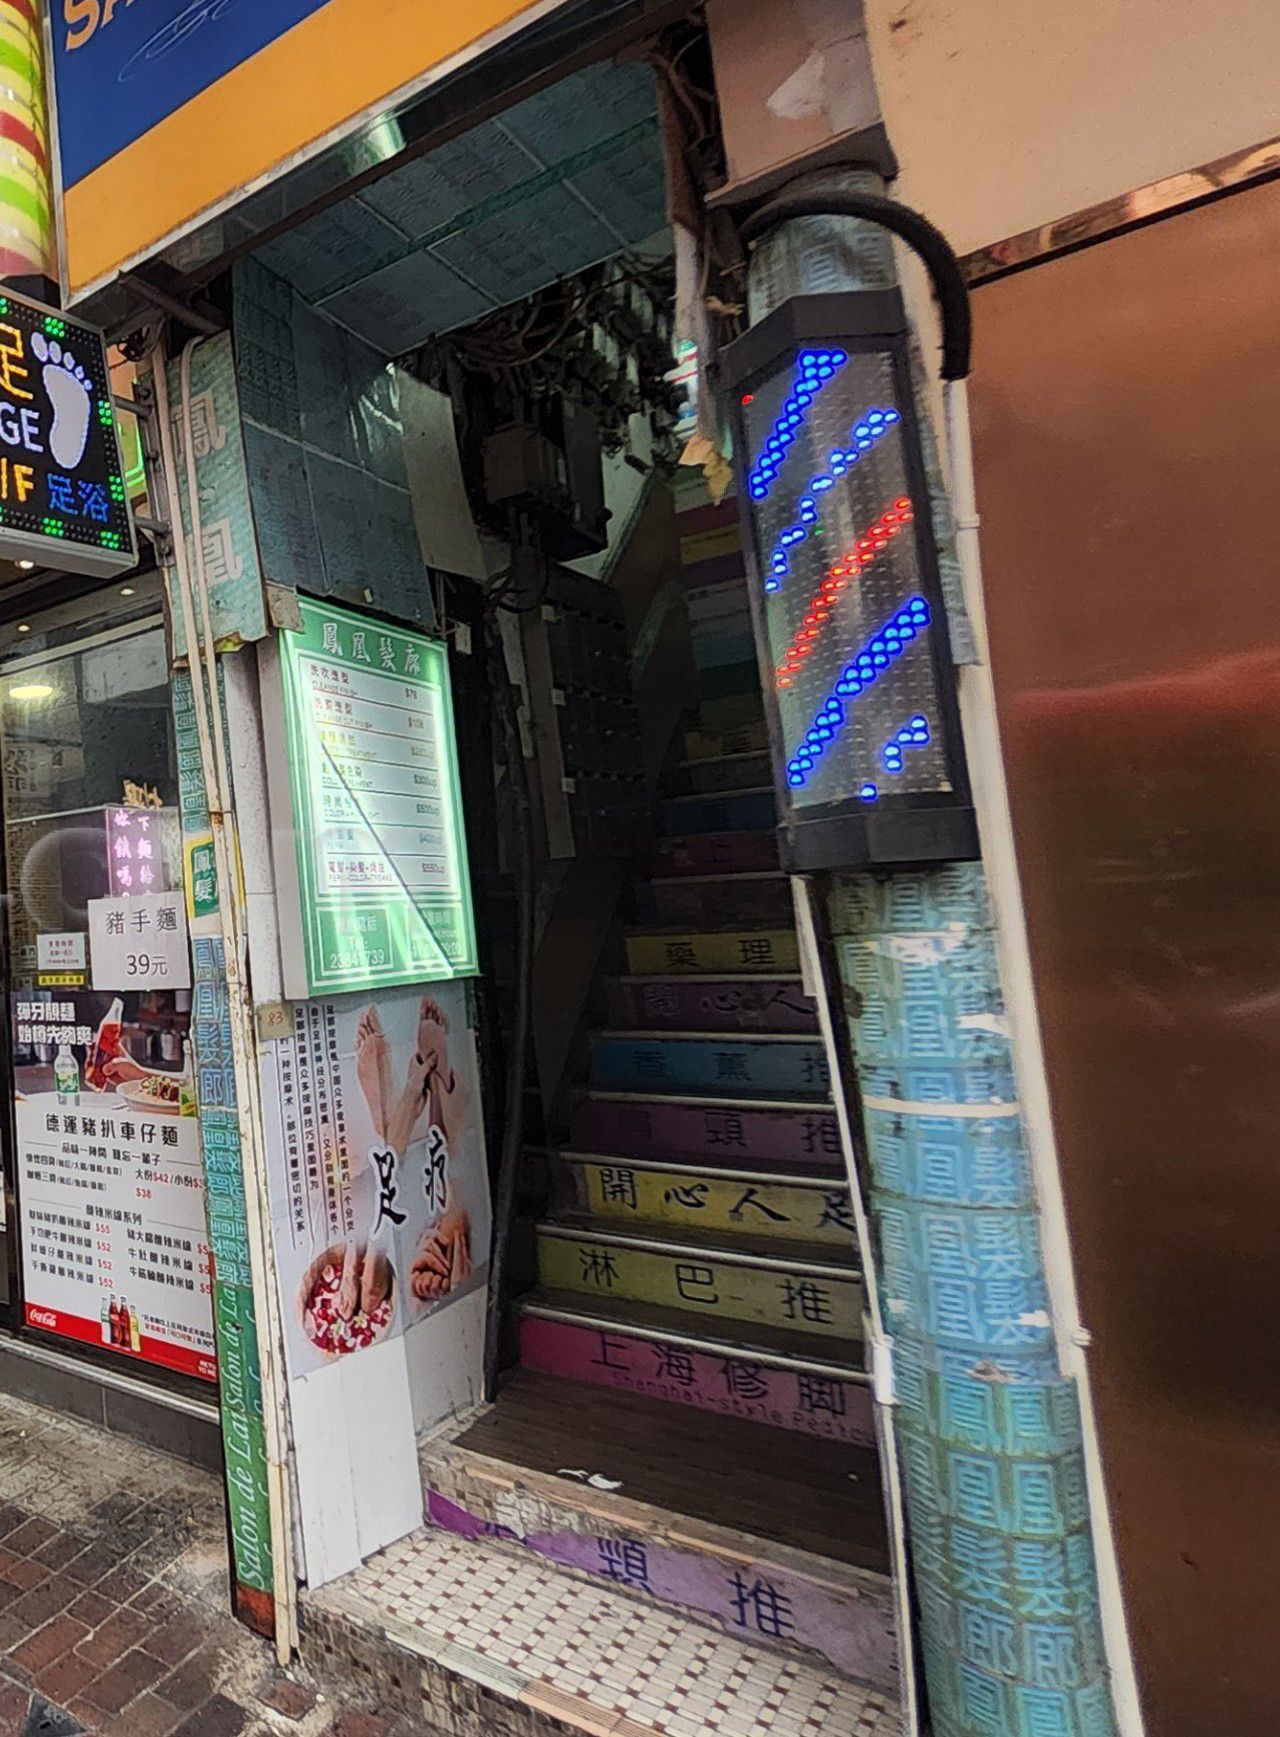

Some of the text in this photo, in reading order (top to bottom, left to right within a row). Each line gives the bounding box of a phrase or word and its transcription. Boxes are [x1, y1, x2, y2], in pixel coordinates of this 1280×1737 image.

[47, 473, 109, 522] 足浴
[106, 906, 179, 935] 豬手麵
[126, 954, 168, 976] 39元
[46, 1113, 179, 1147] 德運豬扒車仔麵
[578, 1247, 834, 1326] 淋巴推
[226, 1466, 256, 1501] de
[232, 1506, 265, 1591] Salon
